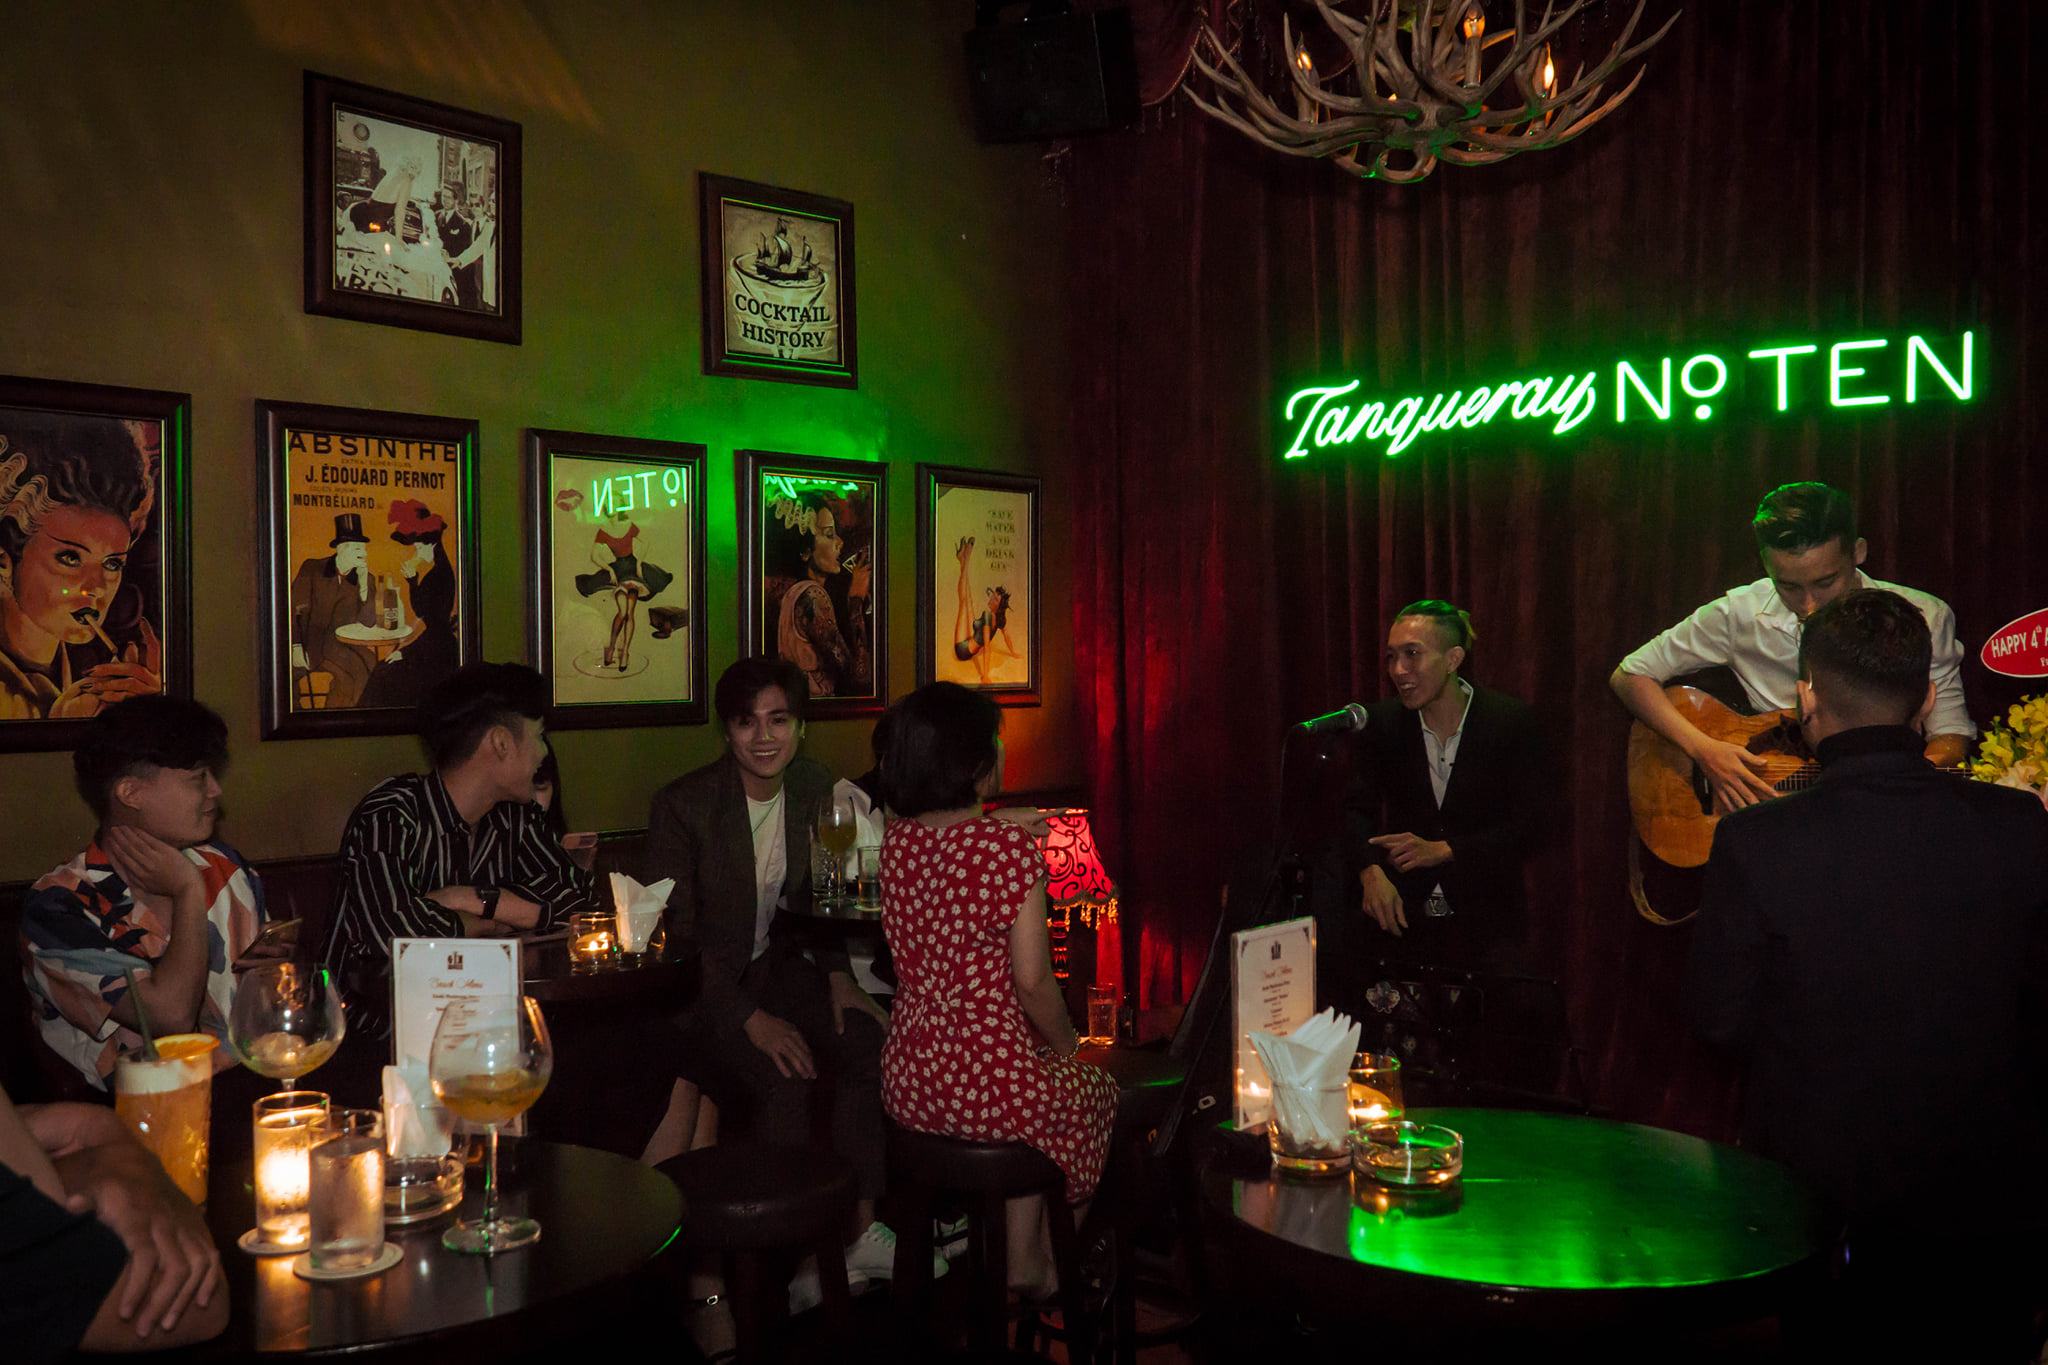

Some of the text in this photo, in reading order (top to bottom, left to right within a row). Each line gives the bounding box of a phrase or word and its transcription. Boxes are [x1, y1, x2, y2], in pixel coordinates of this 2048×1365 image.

[735, 294, 830, 322] COCKTAIL
[742, 321, 825, 348] HISTORY
[1285, 372, 1596, 459] Tanqueray
[1749, 331, 1972, 411] TEN
[289, 432, 457, 462] ABSINTHE
[305, 463, 446, 490] J. ÉDOUARD PERNOT
[293, 493, 376, 510] MONTBÉLIARD
[1991, 632, 2027, 658] HAPPY
